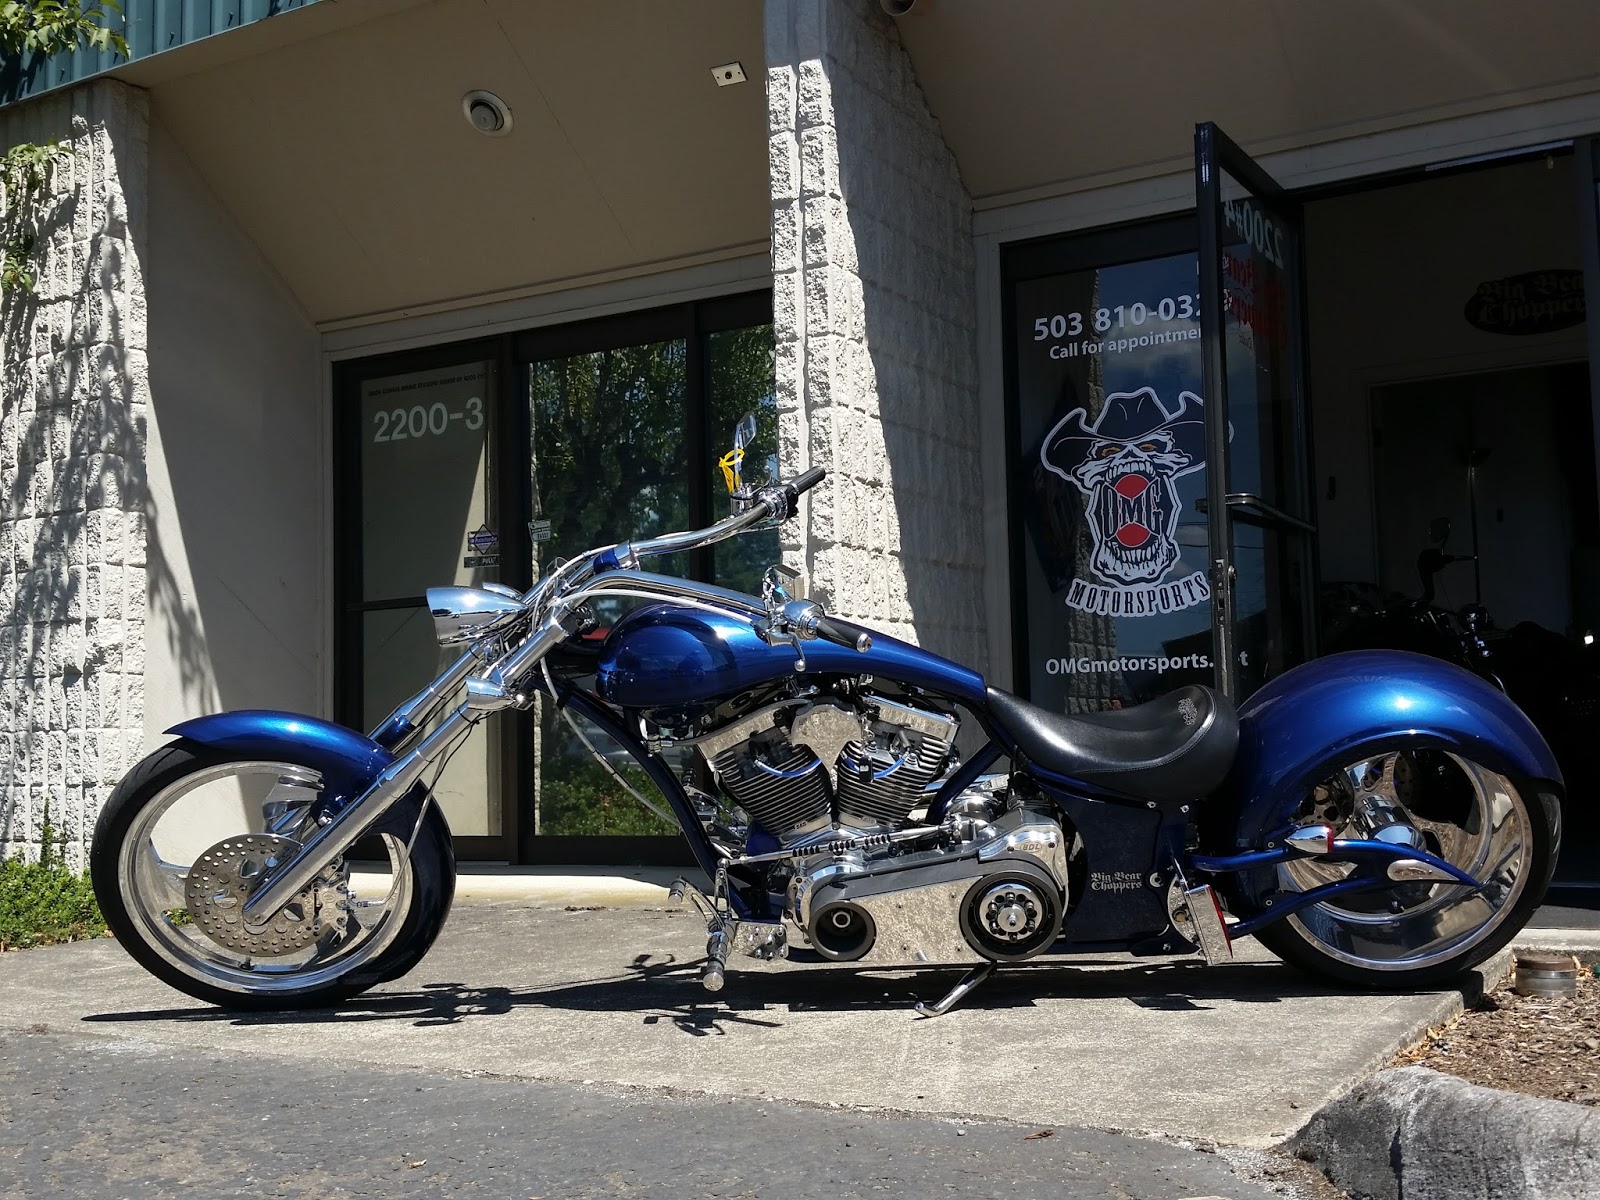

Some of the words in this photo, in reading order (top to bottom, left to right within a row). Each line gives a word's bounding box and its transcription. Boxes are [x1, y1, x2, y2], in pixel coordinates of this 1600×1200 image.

[1536, 271, 1584, 297] Bea
[1033, 312, 1083, 341] 503
[1094, 289, 1232, 332] 810-03
[1049, 342, 1078, 360] Call
[1082, 339, 1104, 354] for
[373, 397, 484, 443] 2200-3
[1101, 477, 1163, 540] OMG
[1069, 574, 1209, 613] MOTORSPORTS
[1045, 650, 1249, 675] OMGmotorsports.t
[1090, 872, 1111, 883] Big
[1113, 871, 1142, 881] Bear
[1091, 881, 1143, 894] Choppers
